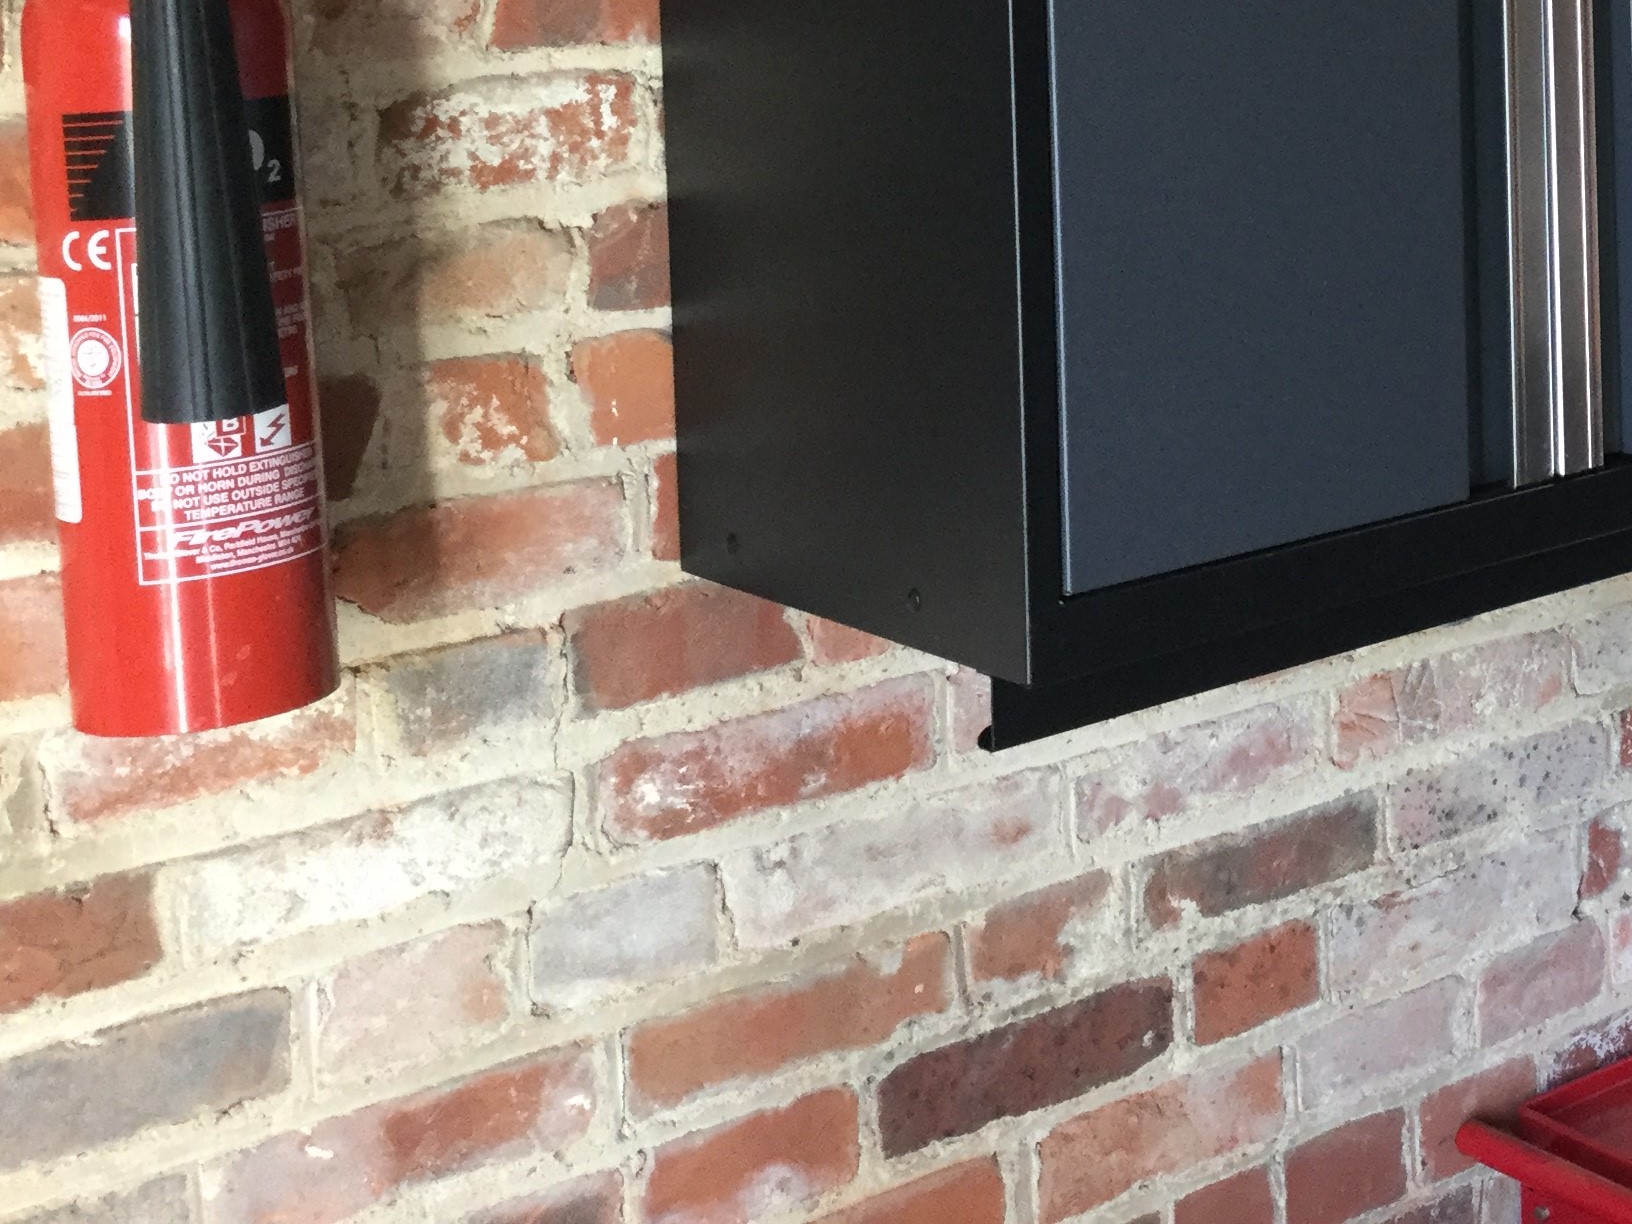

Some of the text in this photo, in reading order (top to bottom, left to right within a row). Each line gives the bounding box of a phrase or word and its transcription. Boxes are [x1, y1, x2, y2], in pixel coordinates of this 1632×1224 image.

[61, 229, 111, 271] CE
[175, 484, 195, 497] OR
[198, 478, 235, 494] HORN
[237, 469, 280, 487] DURING
[183, 469, 209, 483] NOT
[212, 464, 246, 478] HOLD
[173, 496, 200, 509] NOT
[203, 491, 229, 507] USE
[231, 483, 280, 501] OUTSIDE
[184, 487, 305, 522] TEMPERATURE RANGE
